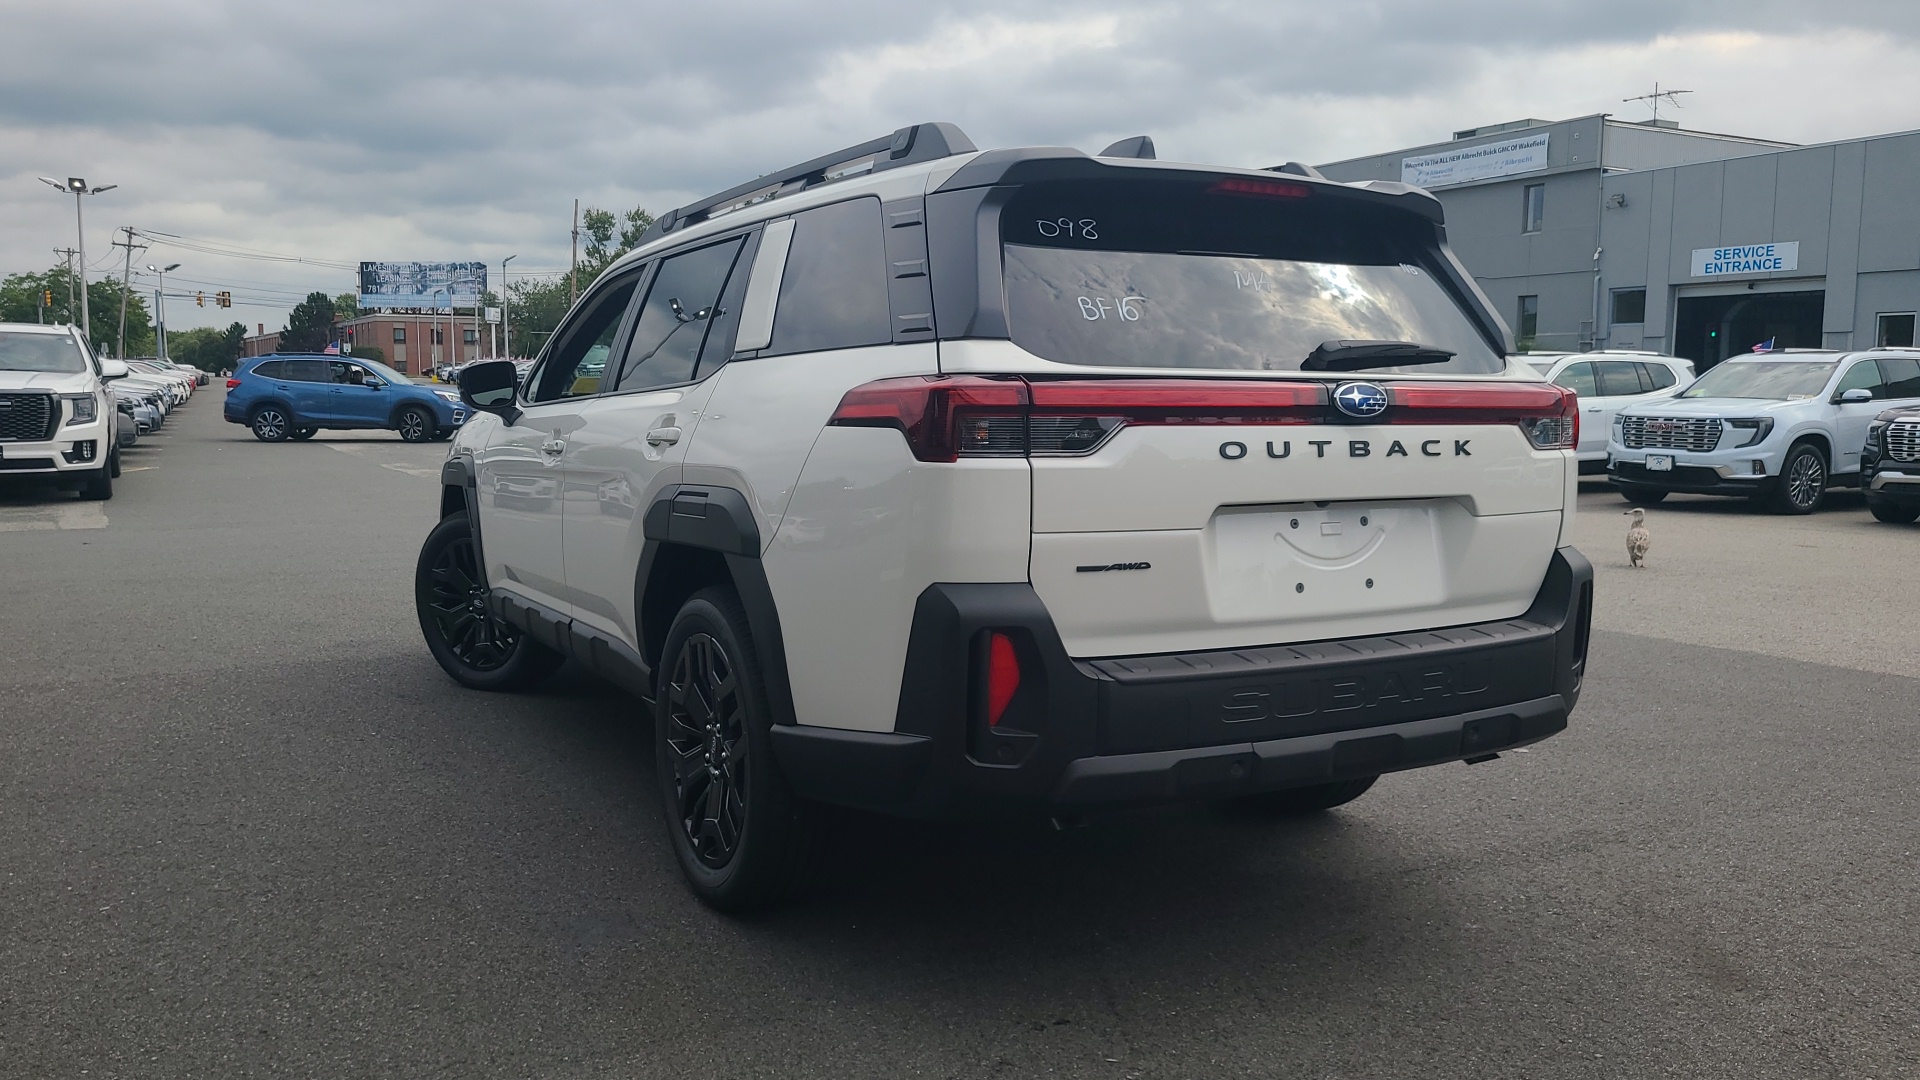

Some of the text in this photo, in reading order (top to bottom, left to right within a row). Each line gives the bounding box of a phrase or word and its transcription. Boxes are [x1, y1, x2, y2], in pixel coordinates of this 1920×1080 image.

[1449, 154, 1461, 162] NEW
[1461, 151, 1482, 160] Albrecht
[1483, 147, 1497, 157] Buick
[1497, 145, 1511, 154] GMC
[1511, 143, 1518, 151] Of
[1518, 139, 1545, 150] Wakefield
[1505, 156, 1533, 166] Albrecht
[1036, 217, 1099, 240] 098
[1713, 245, 1776, 261] SERVICE
[1704, 257, 1783, 274] ENTRANCE
[1219, 440, 1472, 459] OUTBACK
[1104, 561, 1152, 571] AWD
[1221, 658, 1491, 723] SUBARU
